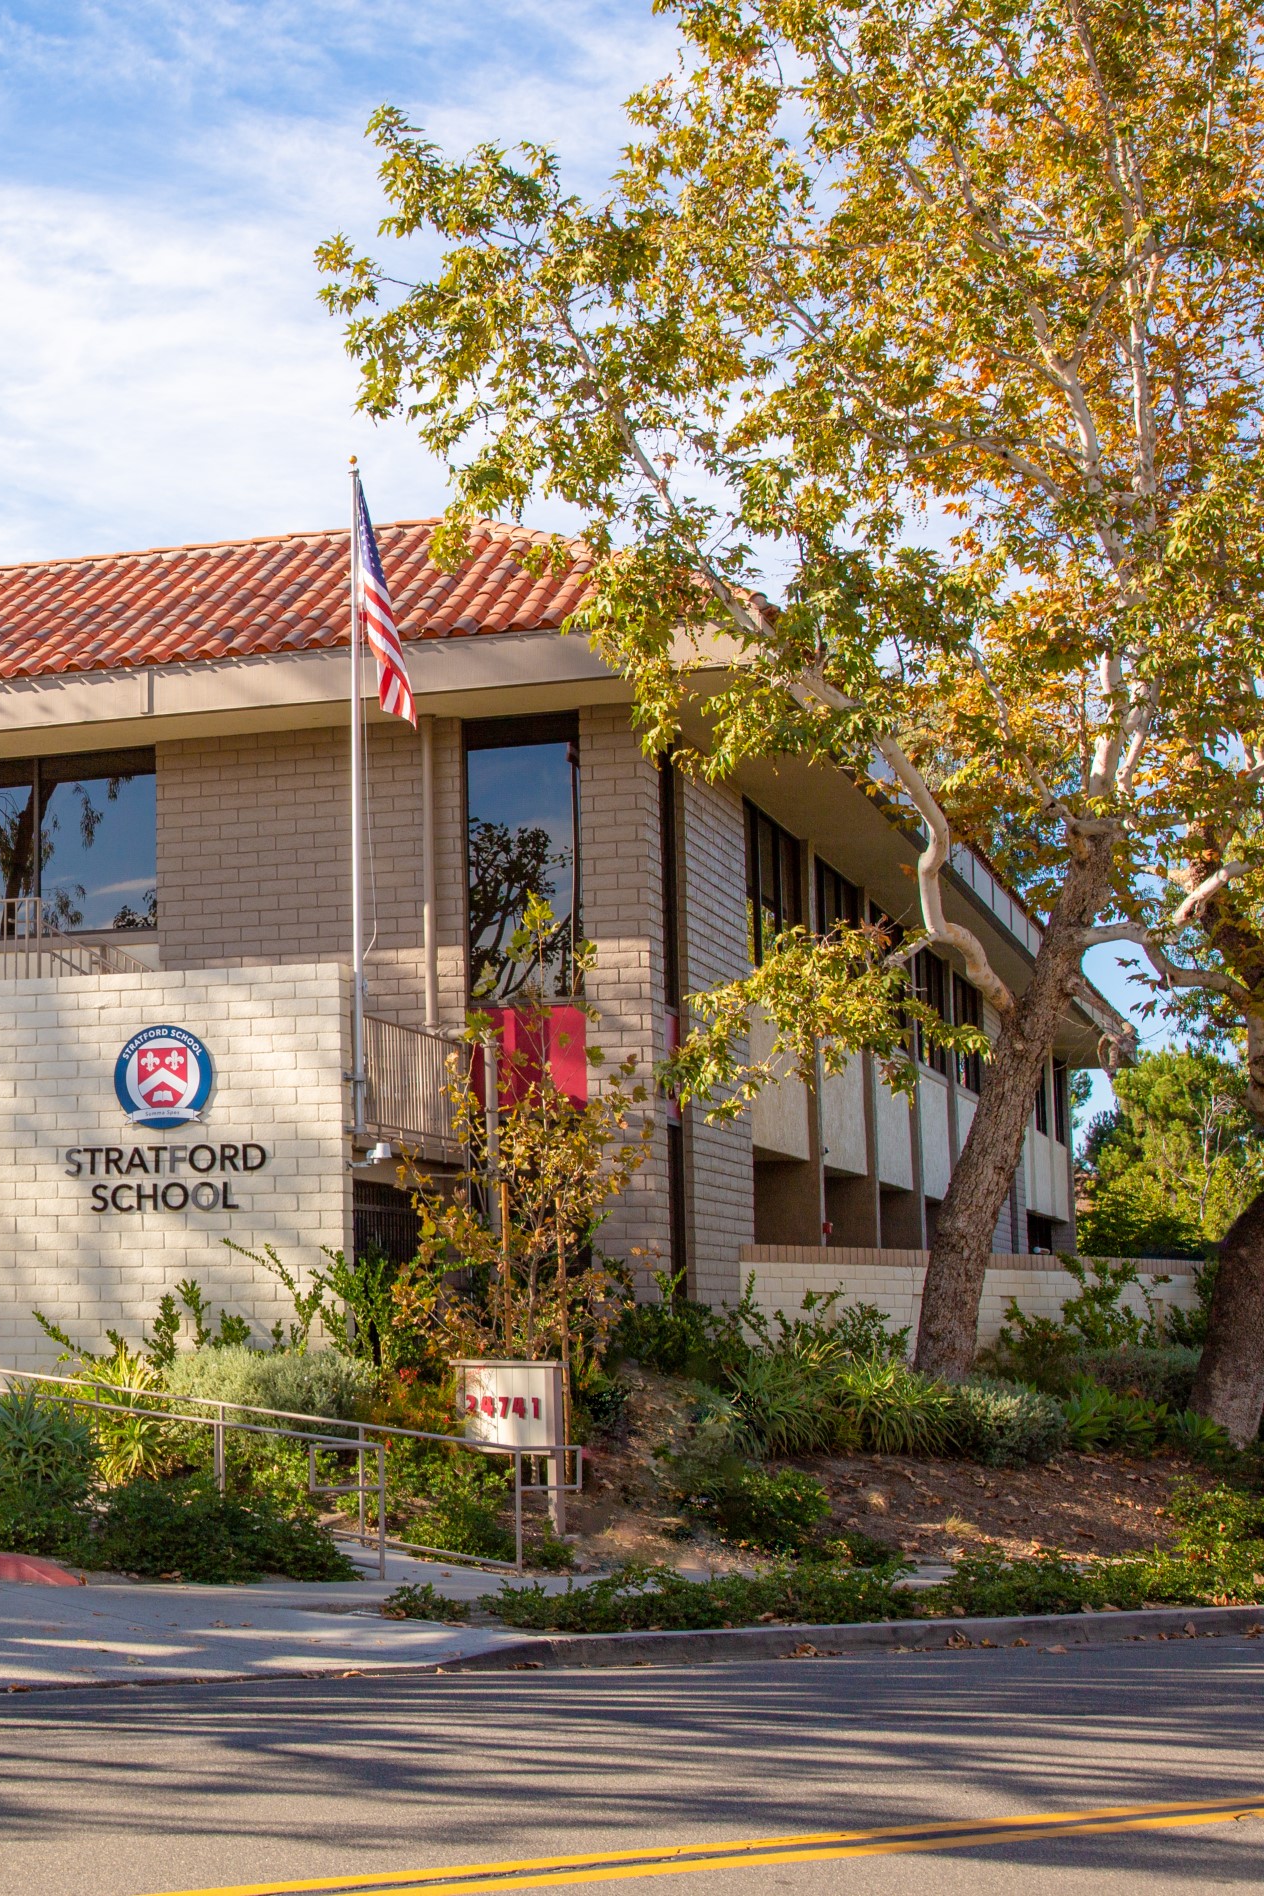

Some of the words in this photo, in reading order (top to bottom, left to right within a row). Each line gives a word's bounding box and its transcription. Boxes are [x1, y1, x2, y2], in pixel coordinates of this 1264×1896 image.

[122, 1028, 168, 1060] STRATFORD
[170, 1029, 203, 1057] SCHOOL
[65, 1143, 267, 1177] STRATFORD
[90, 1181, 240, 1212] SCHOOL
[466, 1394, 540, 1419] 24741
